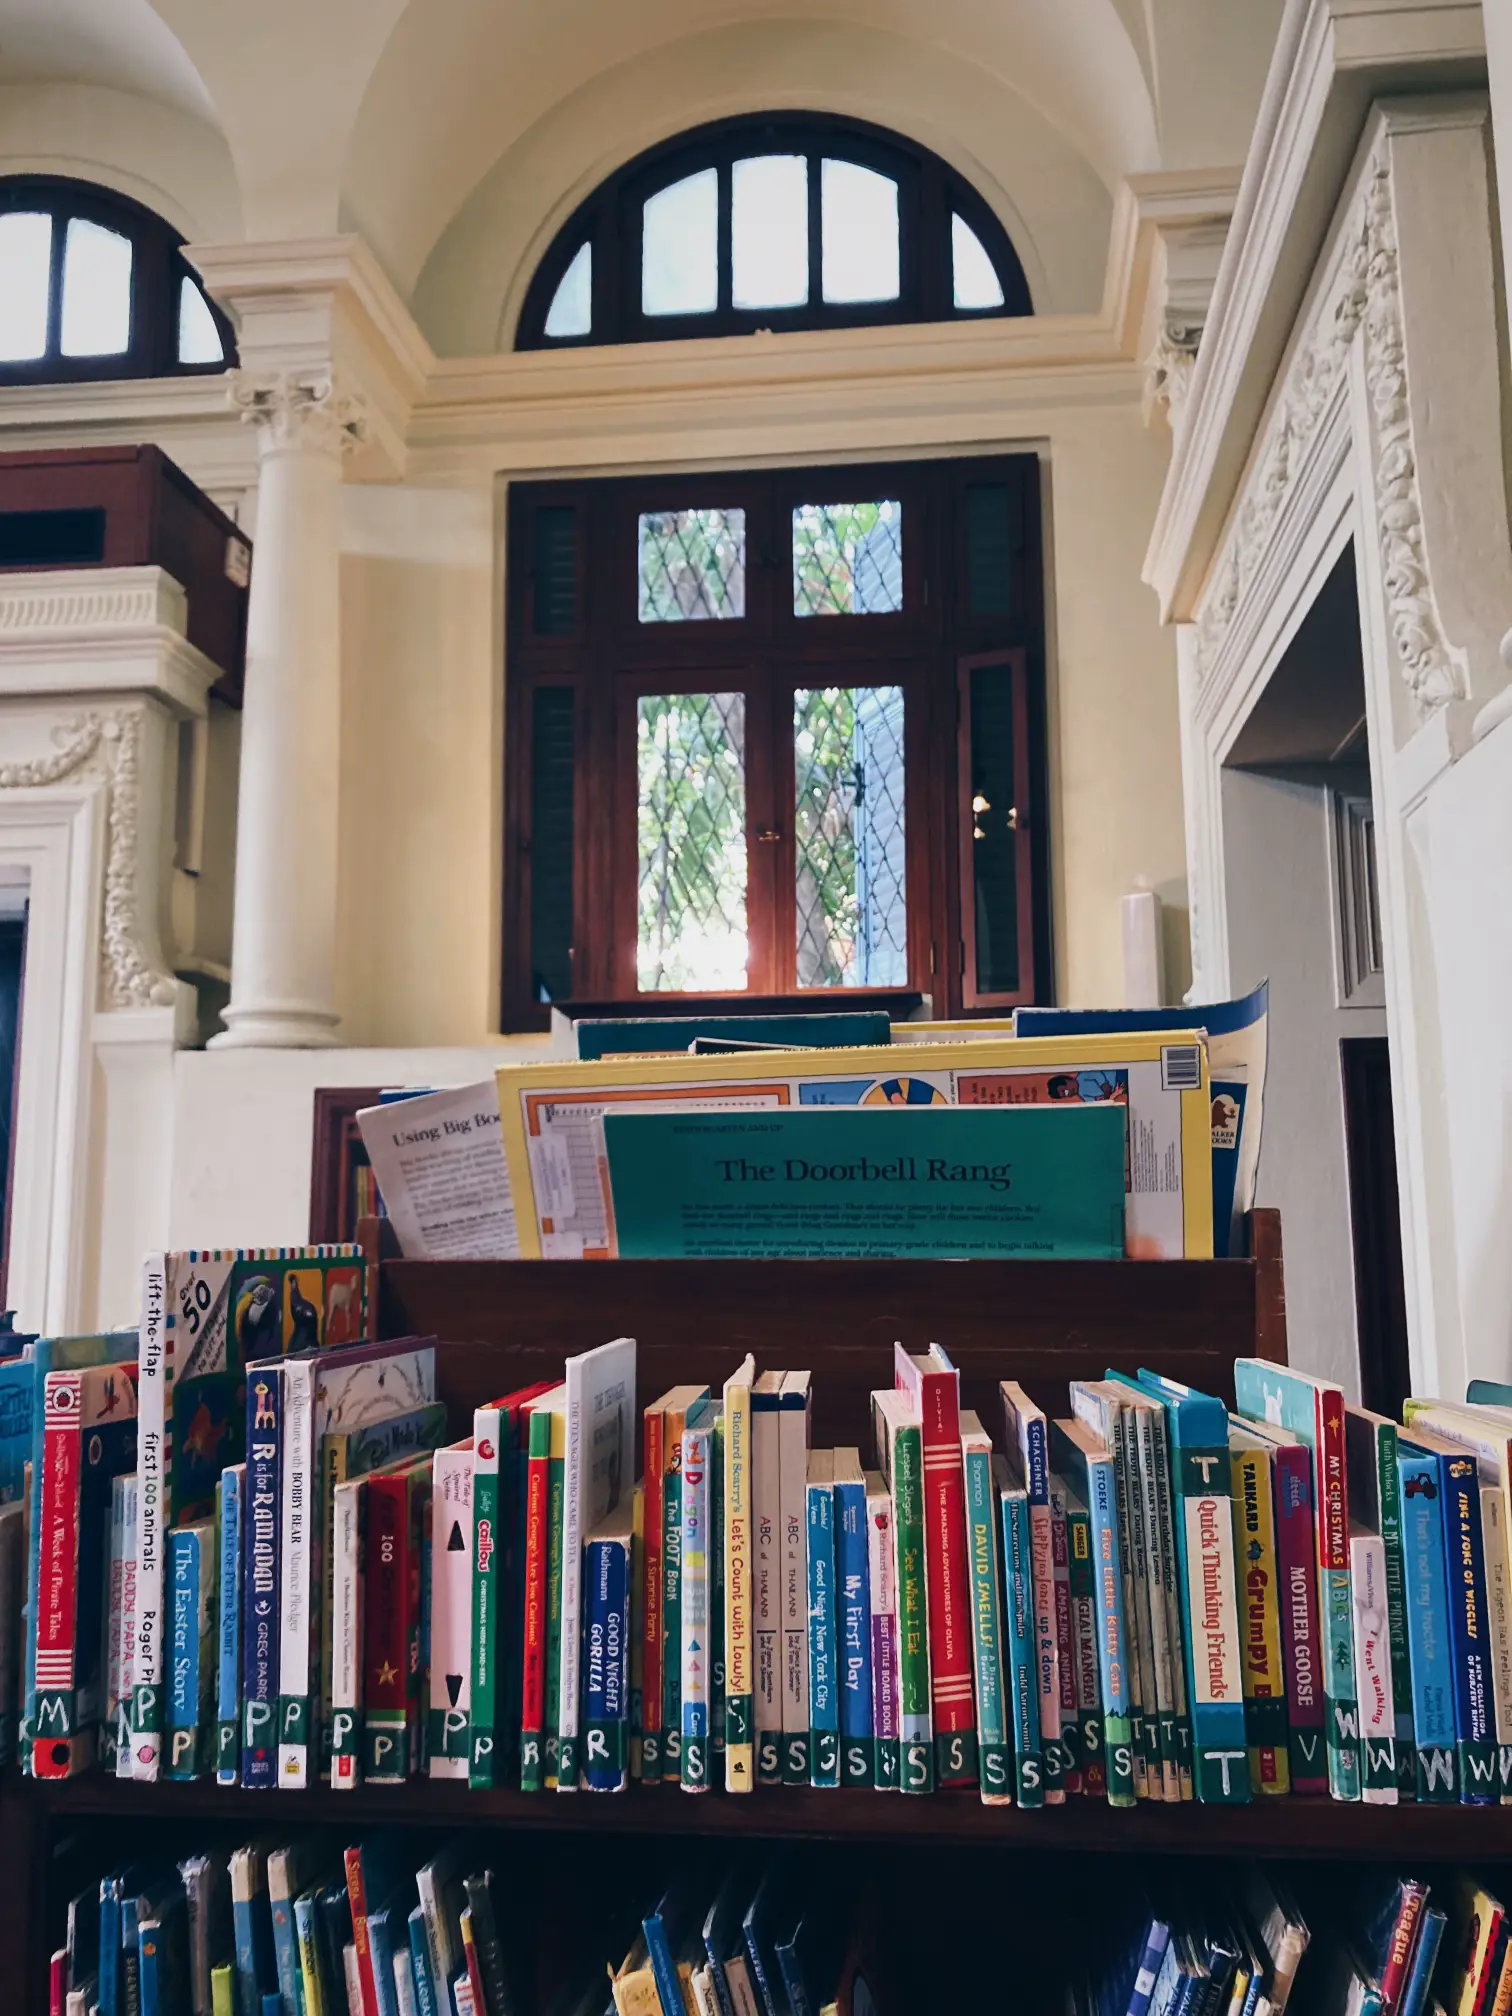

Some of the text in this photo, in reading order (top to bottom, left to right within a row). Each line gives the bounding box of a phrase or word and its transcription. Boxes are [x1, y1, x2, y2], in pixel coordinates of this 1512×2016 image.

[392, 1126, 440, 1147] Using
[443, 1119, 472, 1135] Big
[1211, 1130, 1235, 1138] ALKER
[716, 1156, 1012, 1192] The Doorbell Rang
[180, 1270, 196, 1301] over
[183, 1280, 211, 1335] 50
[138, 1273, 162, 1662] lift-the-flap first 100 animals Roger
[252, 1443, 276, 1461] R
[1031, 1424, 1043, 1496] SCHACHNER
[1129, 1446, 1138, 1476] TEDDY
[1157, 1448, 1167, 1479] TEDDY
[1190, 1456, 1219, 1484] T
[1329, 1455, 1340, 1475] MY
[1383, 1439, 1392, 1460] Ruth
[291, 1472, 303, 1509] BOBBY
[529, 1473, 541, 1513] Curious
[1242, 1462, 1259, 1533] TANKARD
[52, 1514, 65, 1526] A
[291, 1514, 302, 1544] BEAR
[528, 1516, 540, 1557] George's
[941, 1508, 949, 1550] AMAZING
[1144, 1448, 1161, 1585] TEDDY Dancing Lesson
[1329, 1481, 1344, 1565] CHRISTMAS
[51, 1527, 65, 1558] Week
[252, 1492, 274, 1594] RAMADAN
[381, 1534, 394, 1563] 100
[478, 1519, 495, 1573] caillou
[666, 1499, 683, 1601] The FOOT Book
[730, 1411, 745, 1693] Richard Scarry's Let's Count with Lowly!
[973, 1460, 994, 1649] Shannon DAVID SMELLS!
[1075, 1525, 1086, 1556] SANGER
[1384, 1530, 1399, 1548] MY
[51, 1560, 63, 1574] of
[528, 1560, 539, 1580] Are
[599, 1545, 611, 1601] Rathmann
[760, 1516, 772, 1618] ABC THAILAND
[788, 1515, 799, 1617] ABC THAILAND
[815, 1559, 826, 1587] Good
[943, 1551, 951, 1611] ADVENTURES
[1096, 1470, 1121, 1696] STOEKE Five Little Kitty Cats
[1386, 1554, 1401, 1594] LITTLE
[1457, 1491, 1478, 1639] SING A SONG OF WIGGLES
[50, 1577, 63, 1609] Pirate
[221, 1517, 238, 1657] TALE OF PETER RABBIT
[479, 1579, 488, 1625] CHRISTMAS
[528, 1581, 539, 1601] You
[904, 1548, 920, 1656] See What Eat
[1197, 1499, 1229, 1699] Quick Thinking Friends
[48, 1611, 62, 1641] Tales
[173, 1545, 193, 1710] The Easter Story
[256, 1622, 268, 1657] GREG
[527, 1601, 539, 1646] Curious?
[607, 1612, 621, 1657] GOOD
[815, 1624, 827, 1651] New
[844, 1574, 864, 1690] My First Day
[944, 1613, 951, 1627] OF
[1290, 1566, 1314, 1706] MOTHER GOOSE
[588, 1623, 603, 1693] GORILLA
[945, 1628, 954, 1660] OLIVIA
[1038, 1616, 1055, 1694] up & down
[1057, 1586, 1073, 1706] AMAZING ANIMALS
[815, 1654, 828, 1682] York
[879, 1616, 891, 1733] BEST LITTLE BOARD BOOK
[1365, 1639, 1386, 1725] Went Walking
[37, 1696, 70, 1732] M
[137, 1687, 156, 1728] P
[815, 1684, 829, 1711] City
[246, 1700, 271, 1748] P
[587, 1729, 610, 1761] R
[687, 1744, 704, 1780] S
[1298, 1734, 1317, 1762] V
[908, 1746, 927, 1786] S
[1204, 1751, 1246, 1796] T
[1418, 1748, 1453, 1791] W
[1468, 1751, 1495, 1782] W
[1392, 1896, 1421, 1965] Teague
